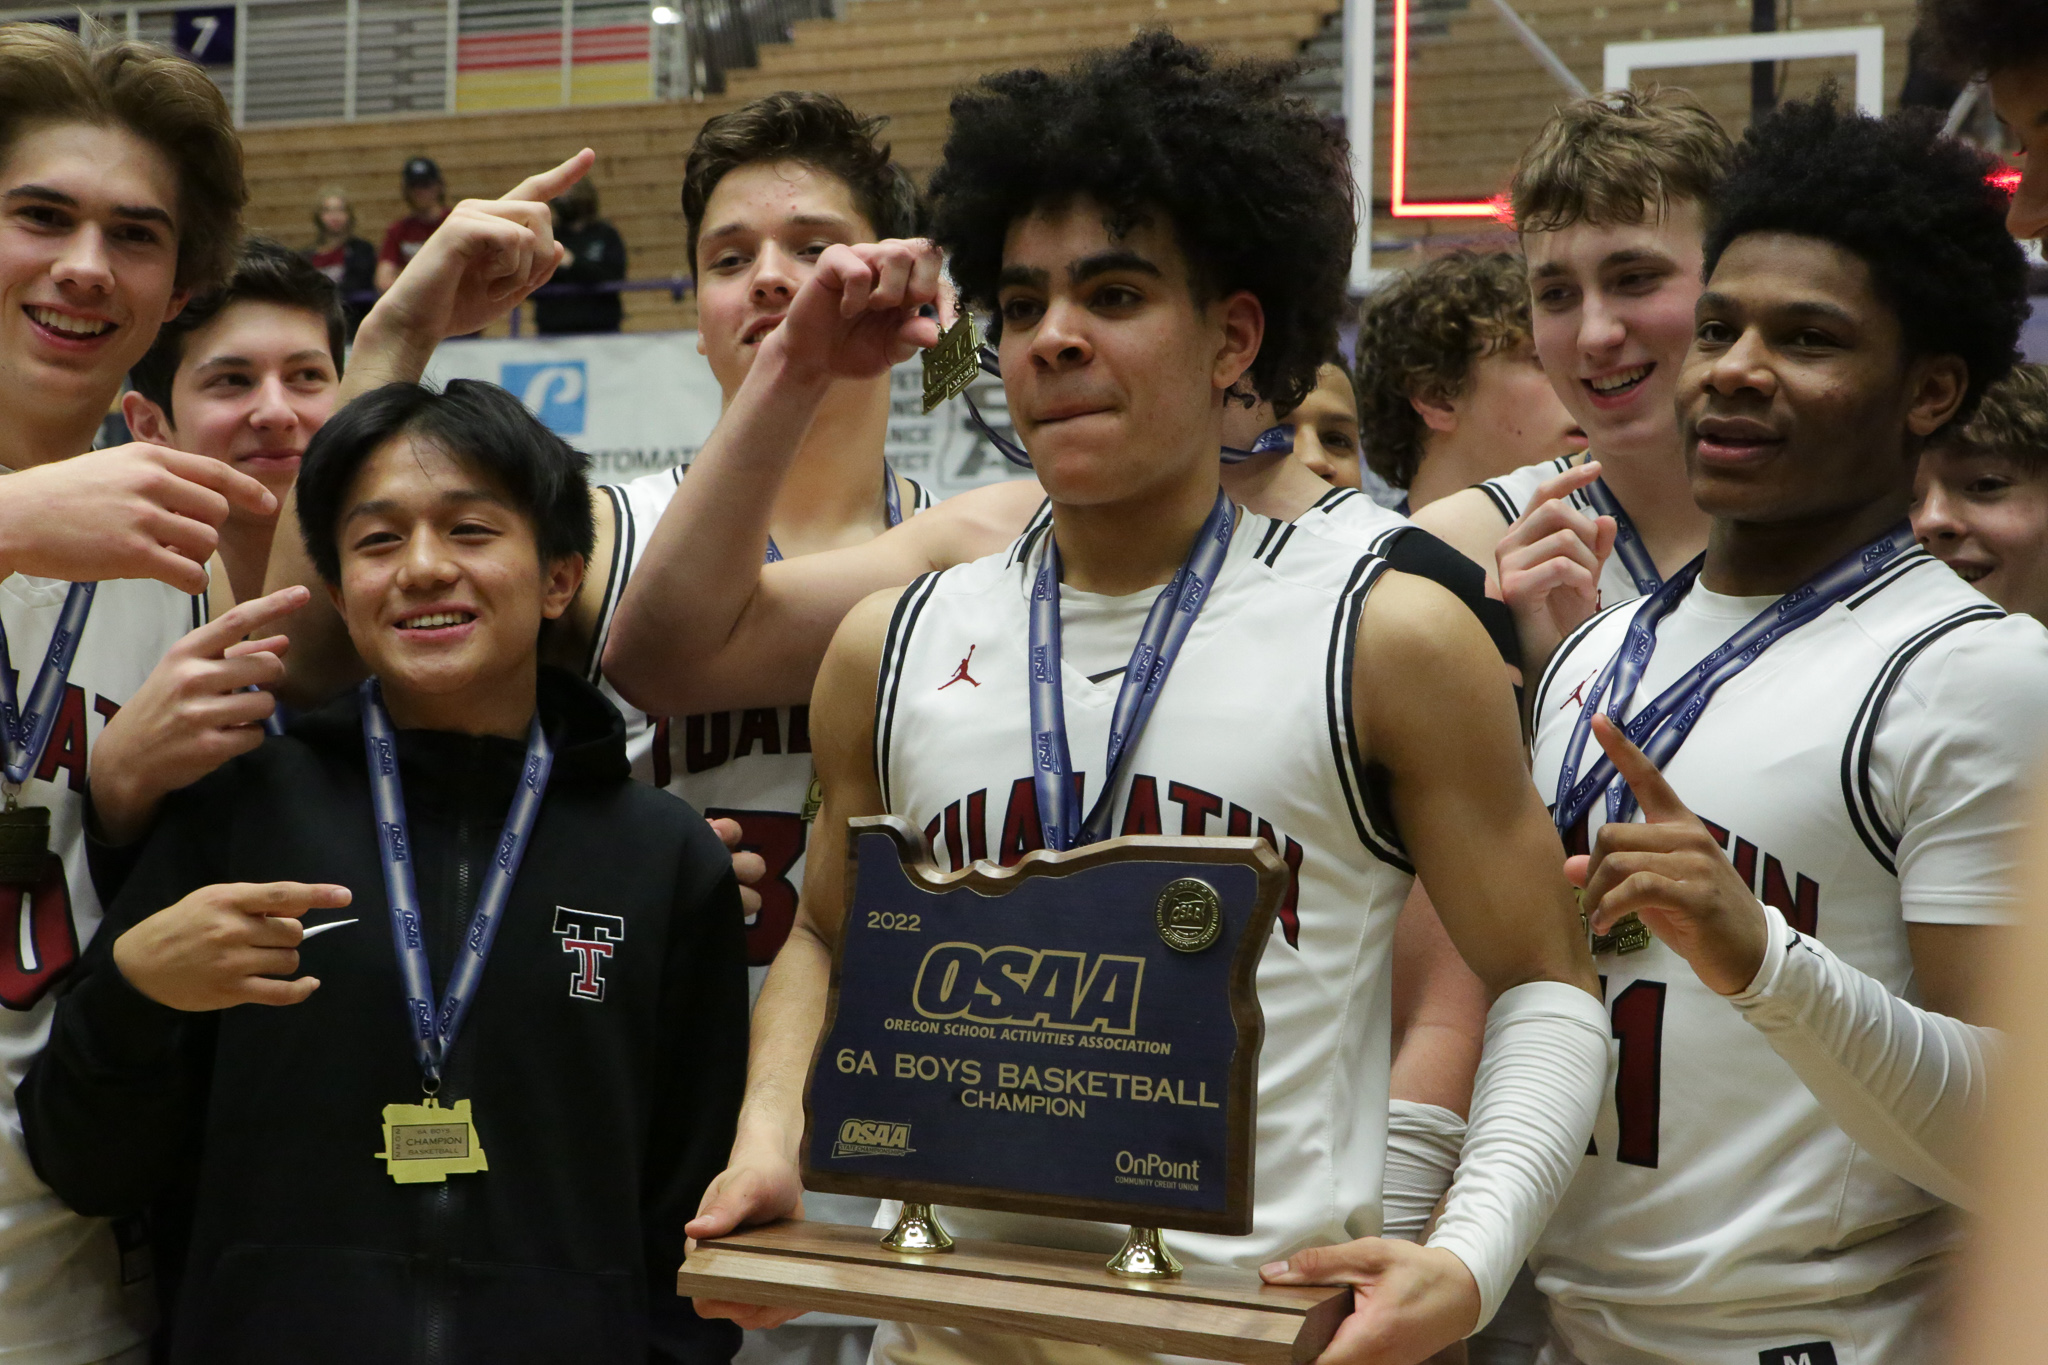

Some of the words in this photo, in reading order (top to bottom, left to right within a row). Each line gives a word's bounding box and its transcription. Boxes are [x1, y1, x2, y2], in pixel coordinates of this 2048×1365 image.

[867, 911, 921, 932] 2022
[912, 941, 1147, 1036] OSAA
[884, 1017, 940, 1035] OREGON
[943, 1022, 997, 1040] SCHOOL
[1000, 1028, 1075, 1047] ACTIVITIES
[1078, 1034, 1172, 1056] ASSOCIATION
[836, 1048, 878, 1076] 6A
[895, 1053, 982, 1085] BOYS
[998, 1063, 1220, 1109] BASKETBALL
[961, 1088, 1087, 1119] CHAMPION
[405, 1136, 463, 1147] CHAMPION
[839, 1119, 911, 1150] OSAA
[408, 1148, 459, 1156] BASKETBALL
[1115, 1150, 1200, 1181] OnPoint
[1115, 1176, 1153, 1187] COMMUNITY
[1154, 1180, 1177, 1190] CREDIT
[1178, 1182, 1199, 1192] UNION
